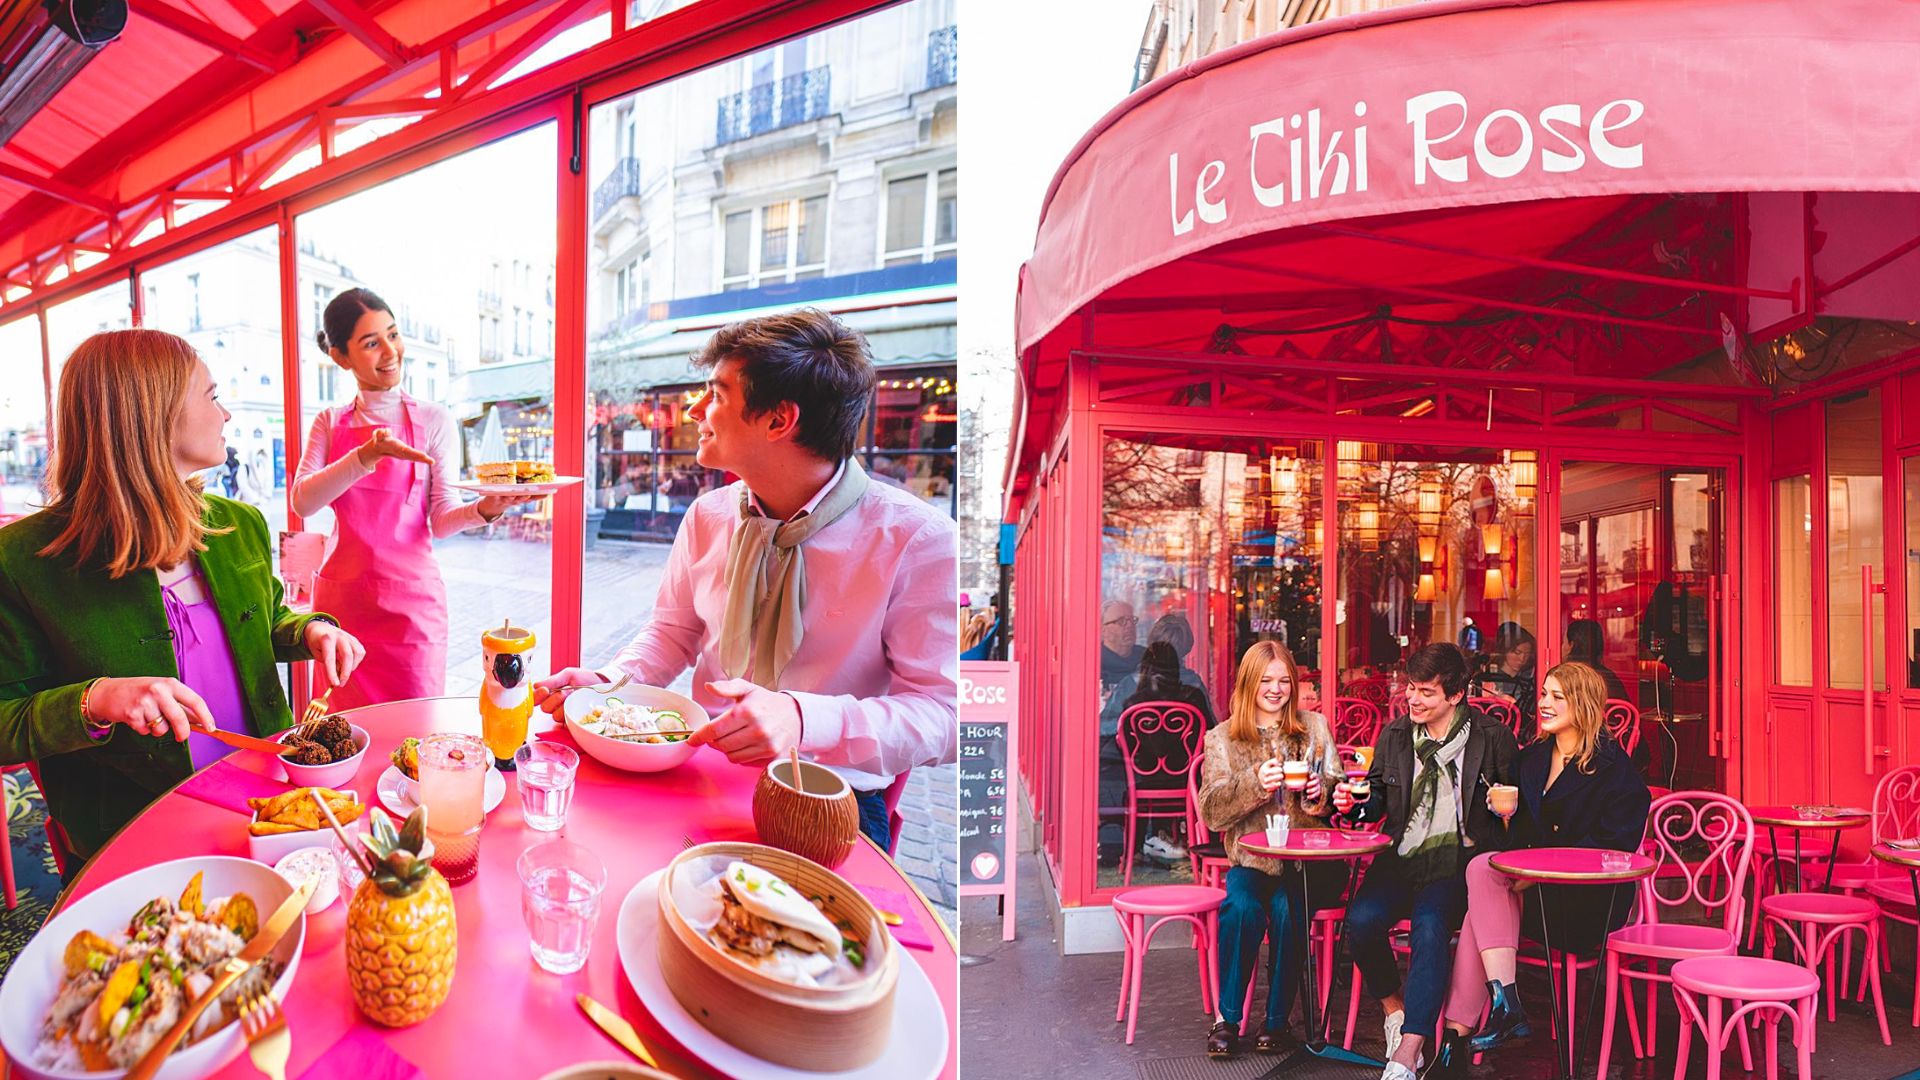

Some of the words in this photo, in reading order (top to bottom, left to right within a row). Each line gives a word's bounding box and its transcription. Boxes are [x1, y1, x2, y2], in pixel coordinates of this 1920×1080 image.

[1169, 152, 1227, 236] Le
[1250, 101, 1368, 208] Tiki
[1406, 90, 1645, 185] Rose
[960, 678, 1006, 704] Rose
[967, 726, 1002, 738] HOUR
